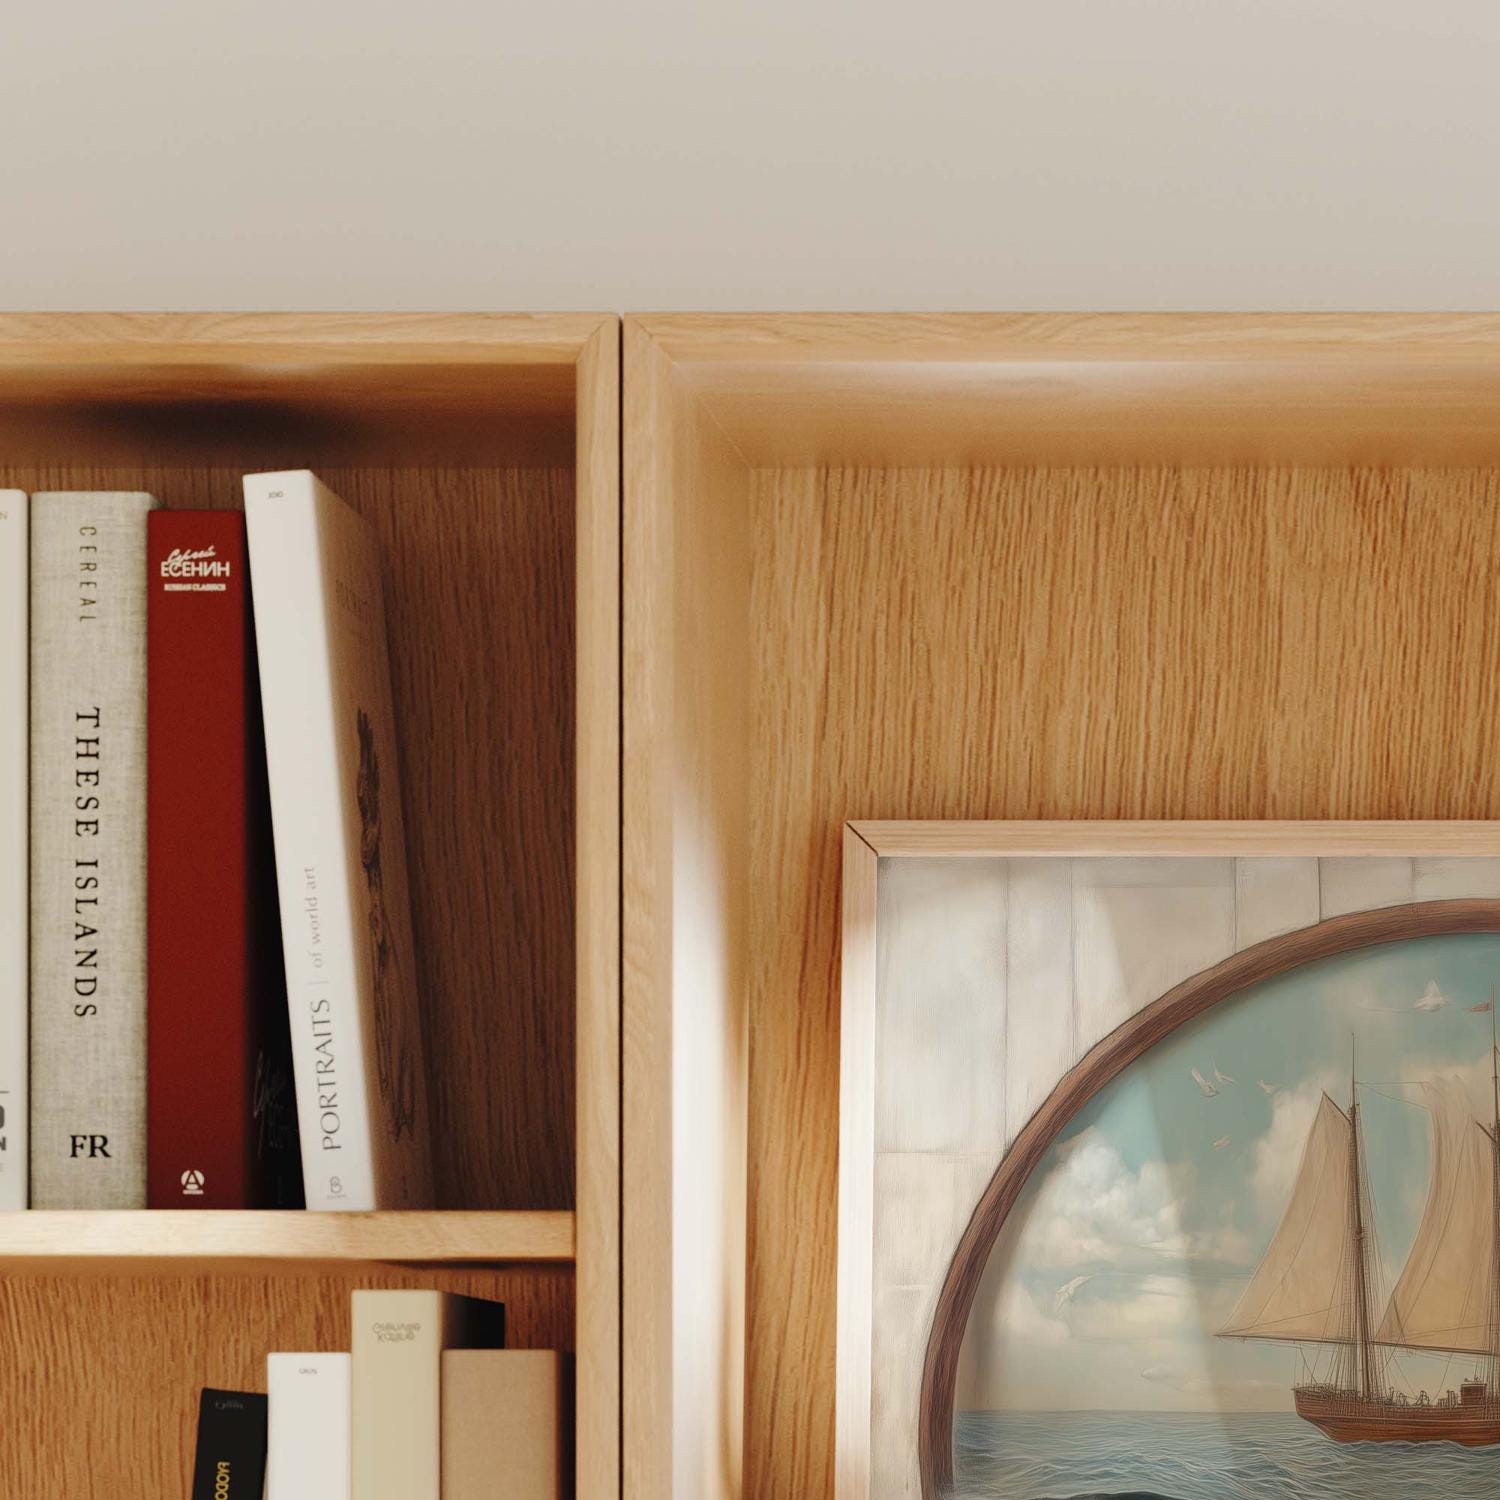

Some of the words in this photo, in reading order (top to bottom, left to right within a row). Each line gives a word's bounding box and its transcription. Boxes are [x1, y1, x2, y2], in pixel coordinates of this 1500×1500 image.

[79, 526, 97, 622] CEREAL
[160, 561, 231, 577] ЕСЕНИН
[76, 707, 101, 837] THESE
[304, 867, 318, 891] art
[74, 859, 99, 1018] ISLANDS
[308, 896, 322, 949] world
[311, 950, 324, 968] of
[310, 998, 342, 1151] PORTRAITS
[69, 1134, 112, 1158] FR
